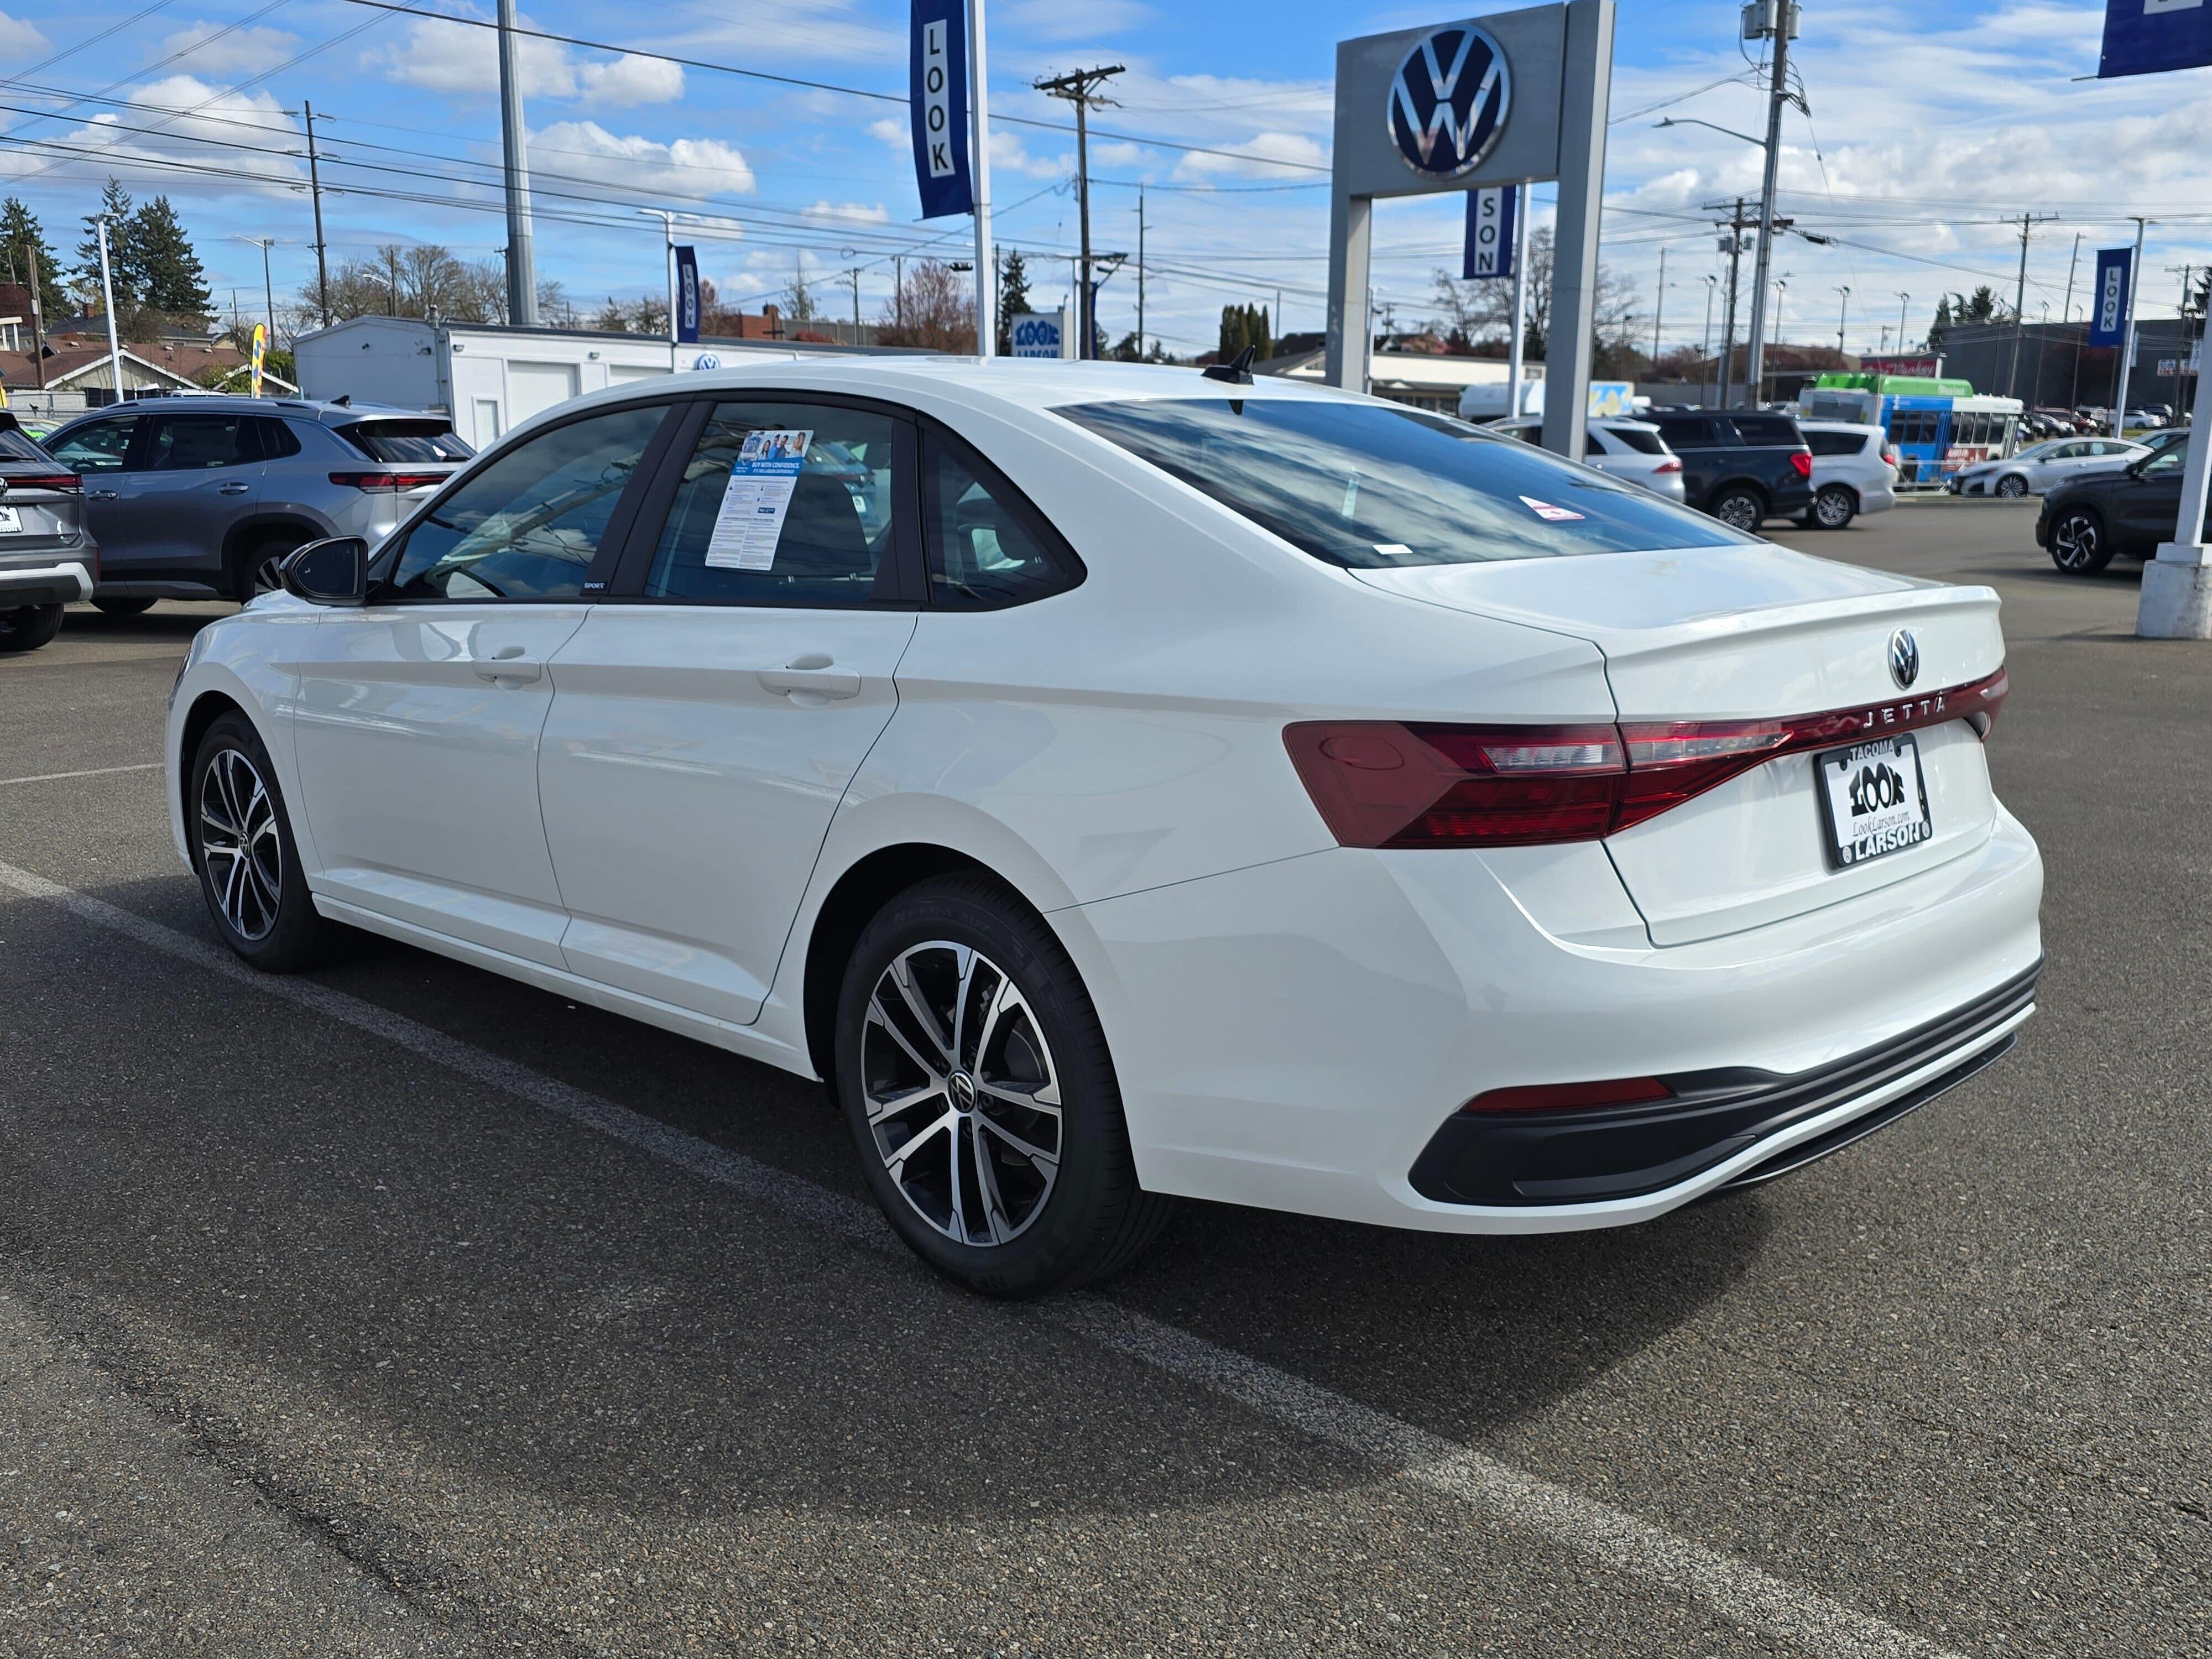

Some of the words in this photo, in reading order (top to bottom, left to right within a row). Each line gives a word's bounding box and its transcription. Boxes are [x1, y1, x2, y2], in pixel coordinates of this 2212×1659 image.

[927, 28, 948, 171] LOOK
[1386, 25, 1511, 179] VW
[685, 267, 693, 324] LOOK
[2103, 269, 2117, 328] LOOK
[1015, 320, 1060, 346] LOOK
[1863, 696, 1946, 728] JETTA
[1850, 739, 1895, 761] TACOMA
[1849, 762, 1906, 817] LOOK
[1853, 811, 1911, 837] LookLarson.com
[1854, 821, 1921, 860] LARSON
